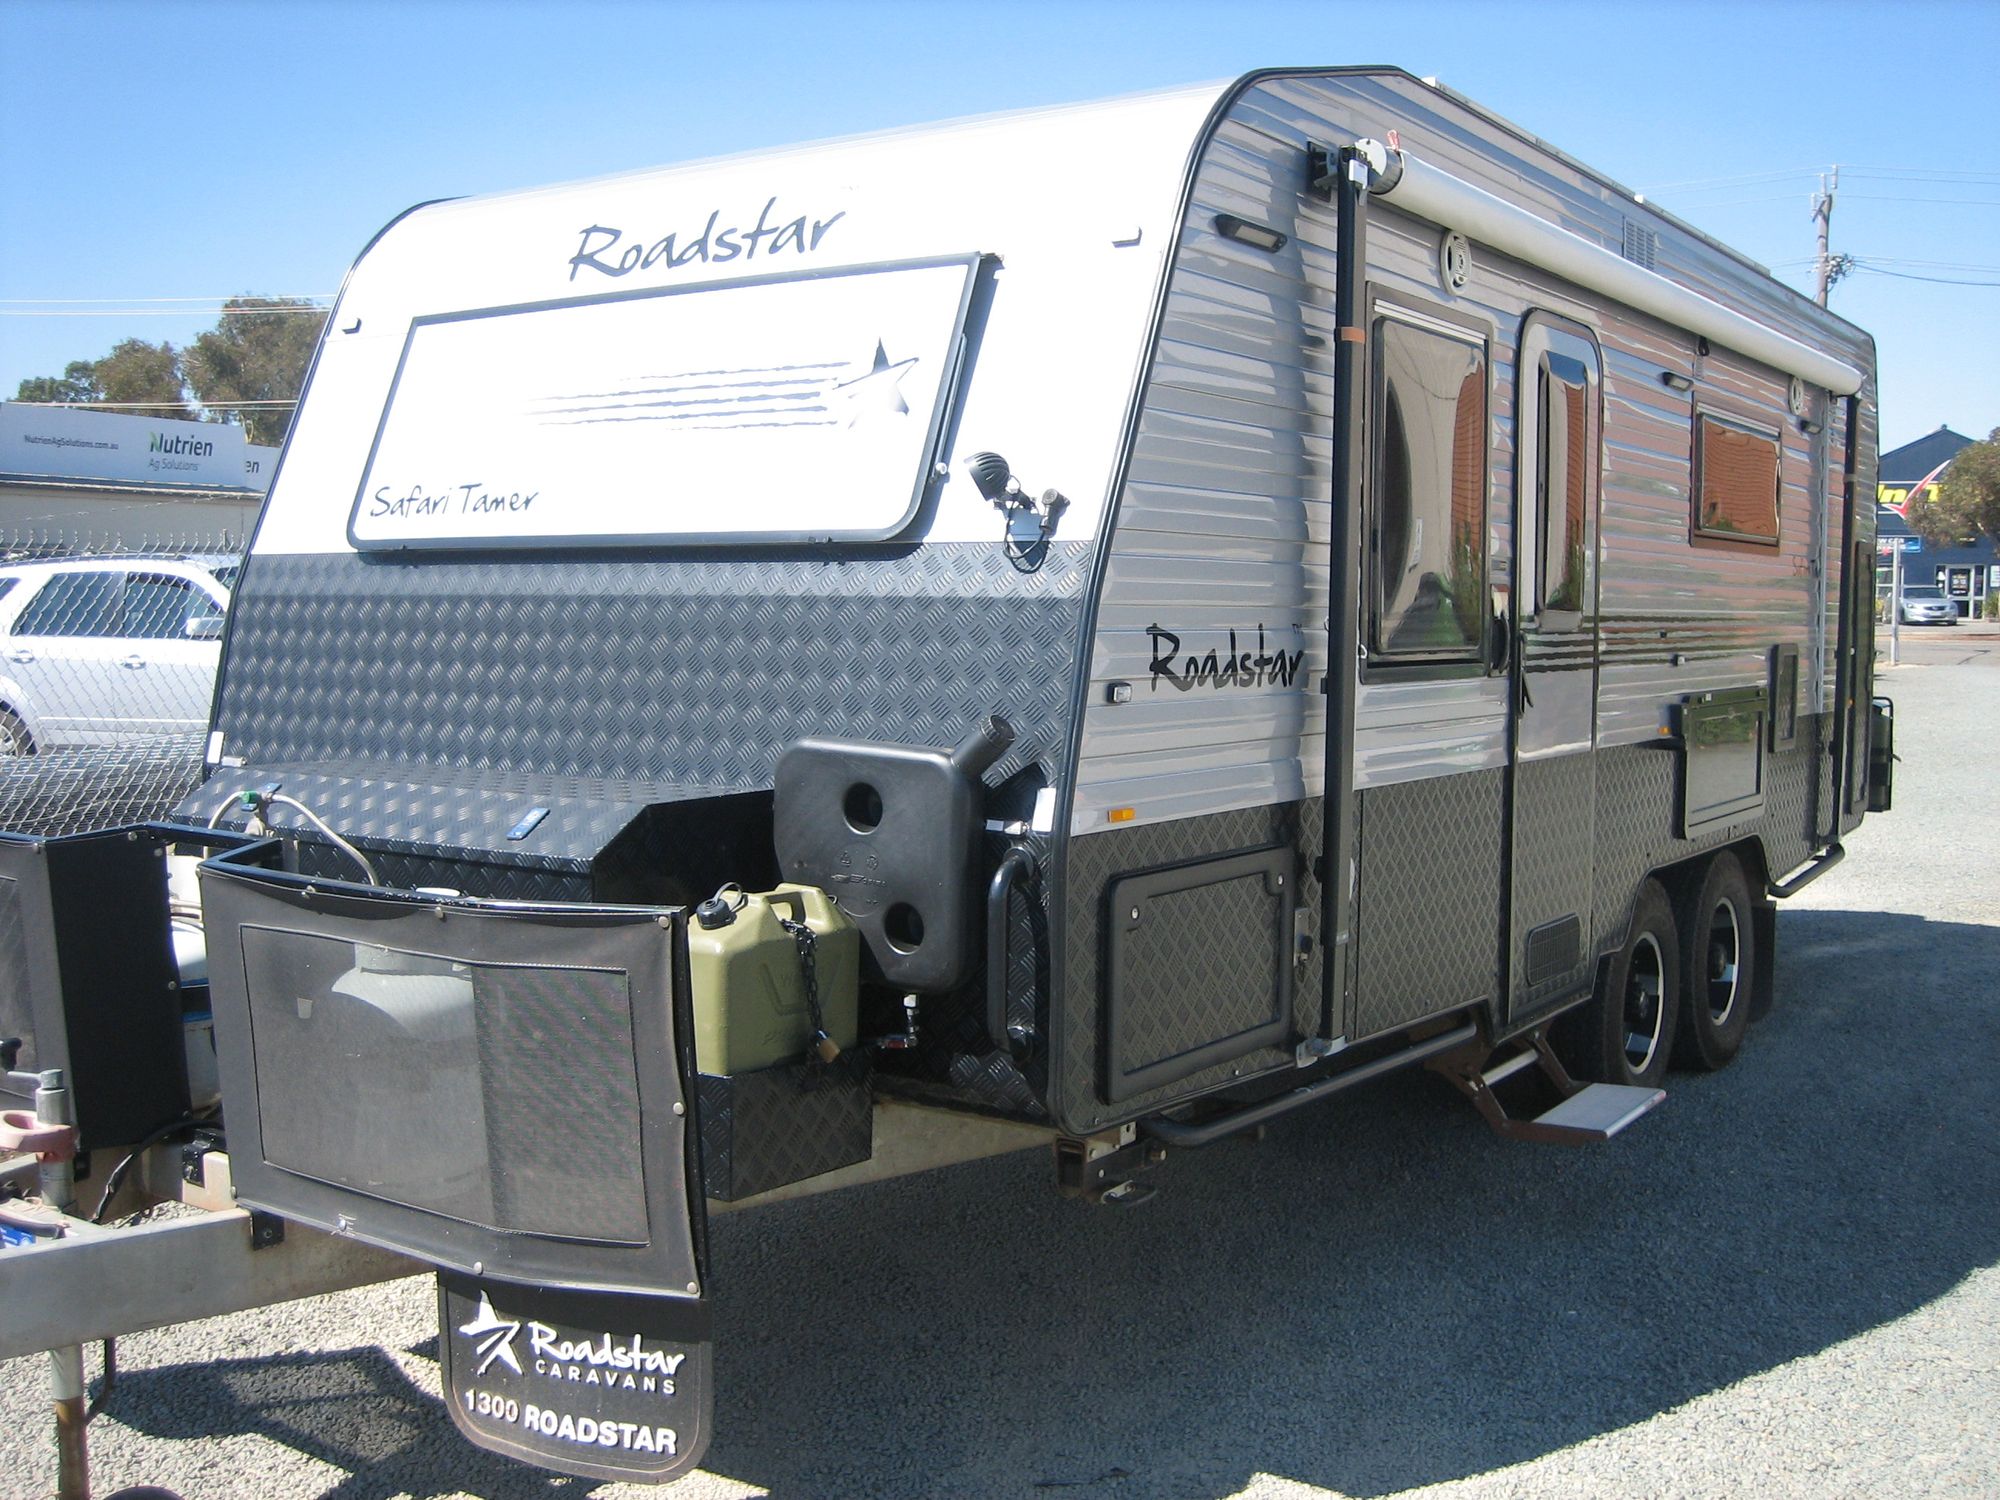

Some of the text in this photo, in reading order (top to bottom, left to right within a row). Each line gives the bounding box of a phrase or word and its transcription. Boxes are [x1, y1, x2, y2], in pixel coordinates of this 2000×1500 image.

[569, 196, 847, 282] Roadstar
[149, 431, 213, 457] Nutrien
[149, 458, 200, 472] Ag Solutions
[370, 483, 539, 518] Safari Tamer
[1146, 623, 1303, 692] Roadstar
[528, 1320, 686, 1376] Roadstar
[535, 1359, 677, 1396] CARAVANS
[465, 1388, 678, 1455] 1300 ROADSTAR
